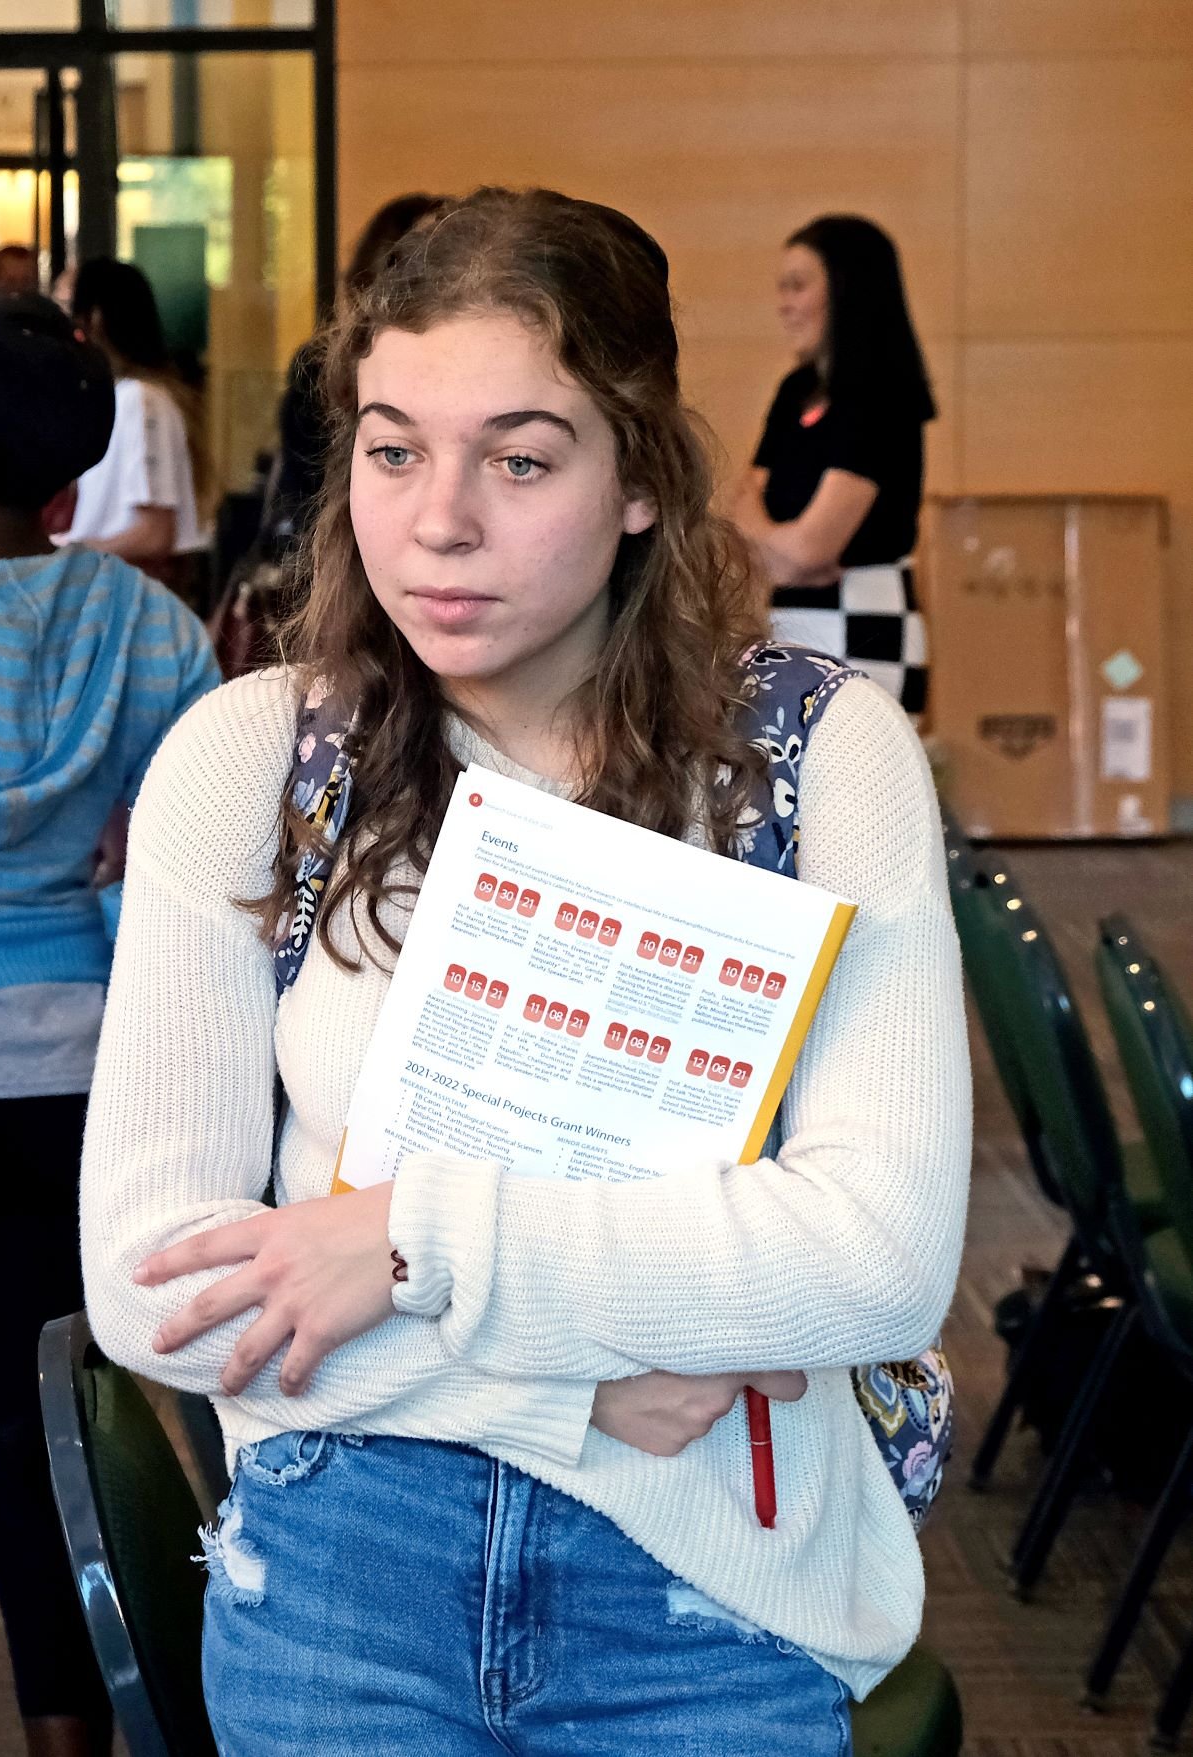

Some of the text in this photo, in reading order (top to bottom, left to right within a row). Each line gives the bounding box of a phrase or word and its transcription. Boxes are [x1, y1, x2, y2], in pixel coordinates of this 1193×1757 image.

[481, 830, 520, 852] Events
[478, 881, 534, 908] 09 30 21
[561, 910, 615, 937] 10 04 21
[642, 939, 697, 965] 10 08 21
[449, 971, 502, 1000] 10 15 21
[725, 966, 780, 991] 10 13 21
[529, 1002, 583, 1029] 11 08 21
[610, 1030, 664, 1055] 11 08 21
[692, 1056, 746, 1080] 12 06 21
[400, 1077, 468, 1109] RESEARCH ASSISTANT
[404, 1060, 632, 1146] 2021-2022 Special Projects Grant Winners
[427, 1106, 442, 1116] Clark
[446, 1114, 463, 1125] Earth
[462, 1121, 475, 1131] and
[475, 1127, 516, 1147] Geographical
[516, 1141, 543, 1154] Sciences
[444, 1104, 485, 1126] Psychological
[485, 1121, 509, 1134] Science
[384, 1128, 407, 1142] MAJOR
[407, 1115, 426, 1127] Daniel
[447, 1133, 470, 1148] Biology
[471, 1143, 483, 1151] and
[483, 1147, 514, 1164] Chemistry
[416, 1128, 440, 1143] Williams
[443, 1140, 466, 1156] Biology
[436, 1119, 453, 1130] Lewis
[485, 1139, 510, 1154] Nursing
[557, 1136, 607, 1154] MINOR GRANTS
[567, 1163, 602, 1179] Kyle Moody
[572, 1149, 602, 1161] Katharine
[603, 1157, 624, 1167] Covino
[628, 1164, 650, 1176] English
[582, 1160, 604, 1170] Grimm
[608, 1167, 631, 1179] Biology
